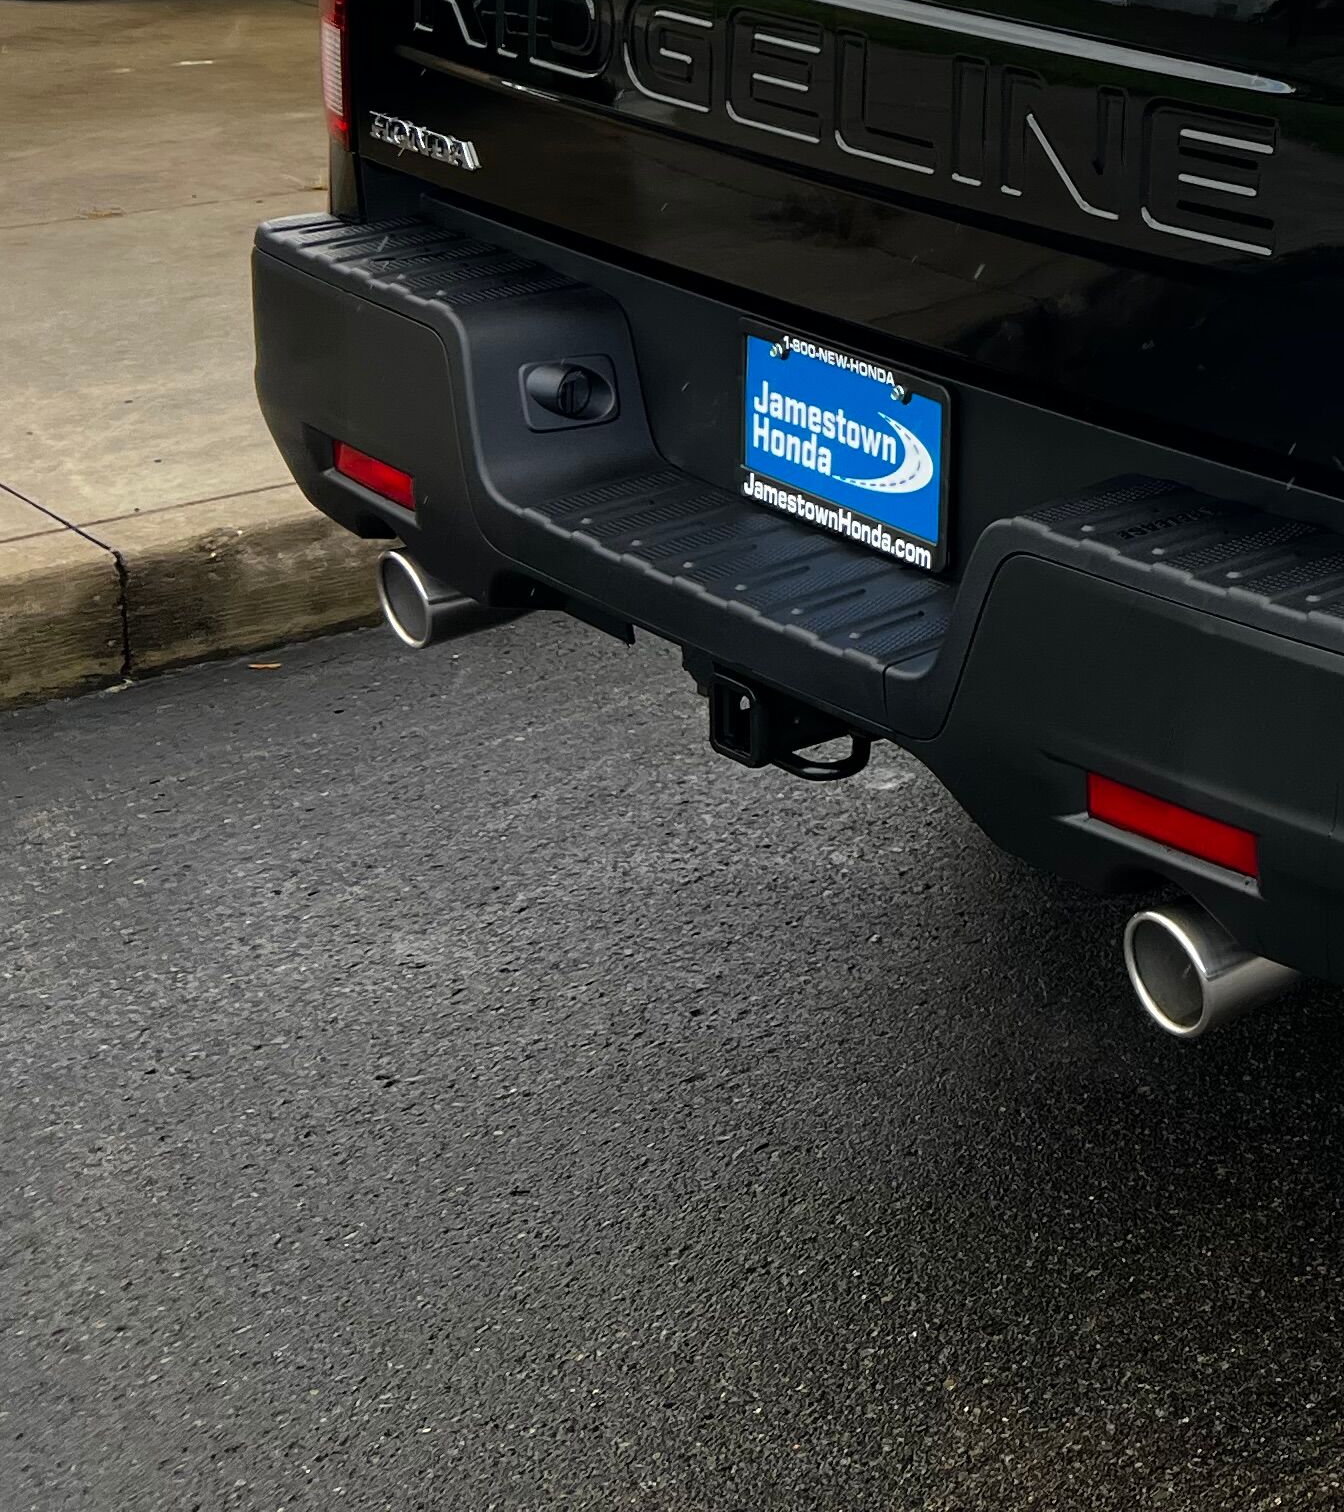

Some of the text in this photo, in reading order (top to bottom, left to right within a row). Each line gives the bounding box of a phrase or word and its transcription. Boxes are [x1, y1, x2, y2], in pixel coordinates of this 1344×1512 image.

[369, 110, 482, 170] HONDA
[783, 335, 896, 387] 1-800-NEW-HONDA
[752, 413, 833, 476] Honda
[753, 380, 897, 465] Jamestown
[743, 472, 932, 570] JamestownHonda.com
